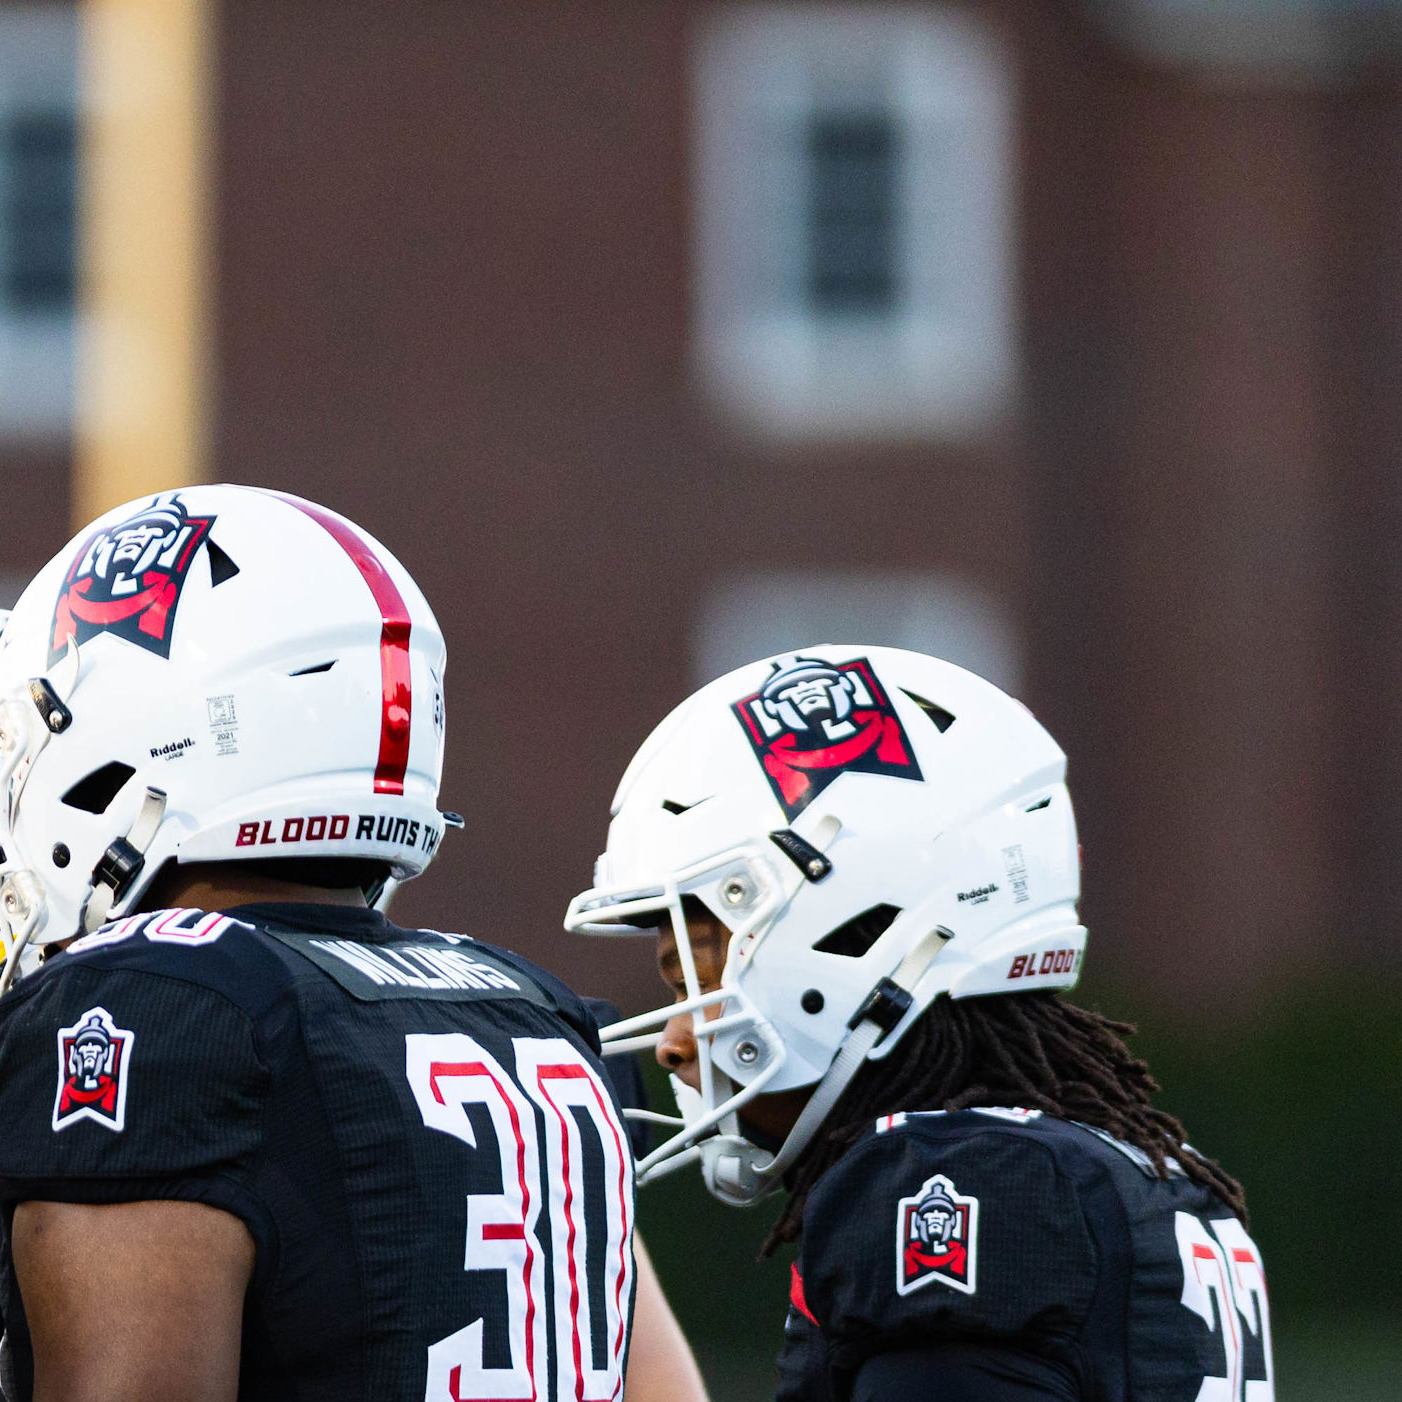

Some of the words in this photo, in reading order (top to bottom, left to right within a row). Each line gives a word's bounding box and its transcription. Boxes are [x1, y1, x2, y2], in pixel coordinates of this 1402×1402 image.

[149, 737, 193, 758] Riddell
[235, 814, 350, 847] BLOOD
[355, 814, 420, 848] RUNS
[1007, 949, 1076, 979] BLOOD
